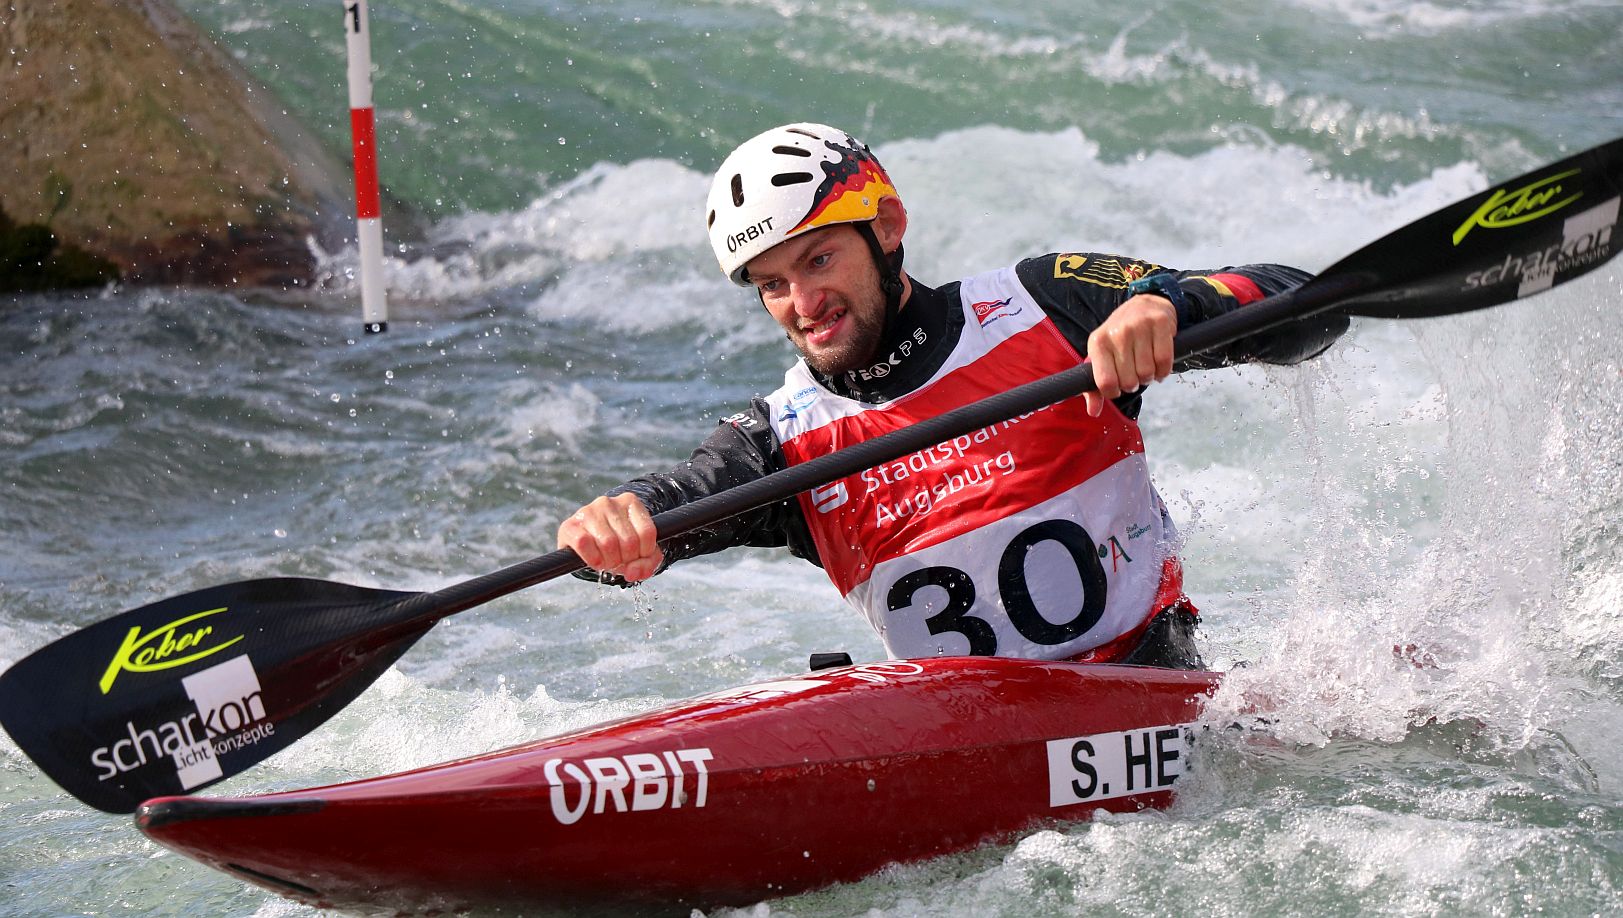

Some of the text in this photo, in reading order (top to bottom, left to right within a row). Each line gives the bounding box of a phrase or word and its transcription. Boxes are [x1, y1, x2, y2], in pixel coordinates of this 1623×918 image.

[727, 217, 774, 253] ORBIT
[1452, 168, 1585, 247] Kober
[876, 450, 1017, 528] Augsburg
[886, 518, 1108, 657] 30
[99, 607, 245, 695] Kober
[91, 690, 267, 781] scharkon
[212, 721, 276, 756] konzepte
[1071, 728, 1196, 798] S. HE
[543, 747, 714, 825] ORBIT
